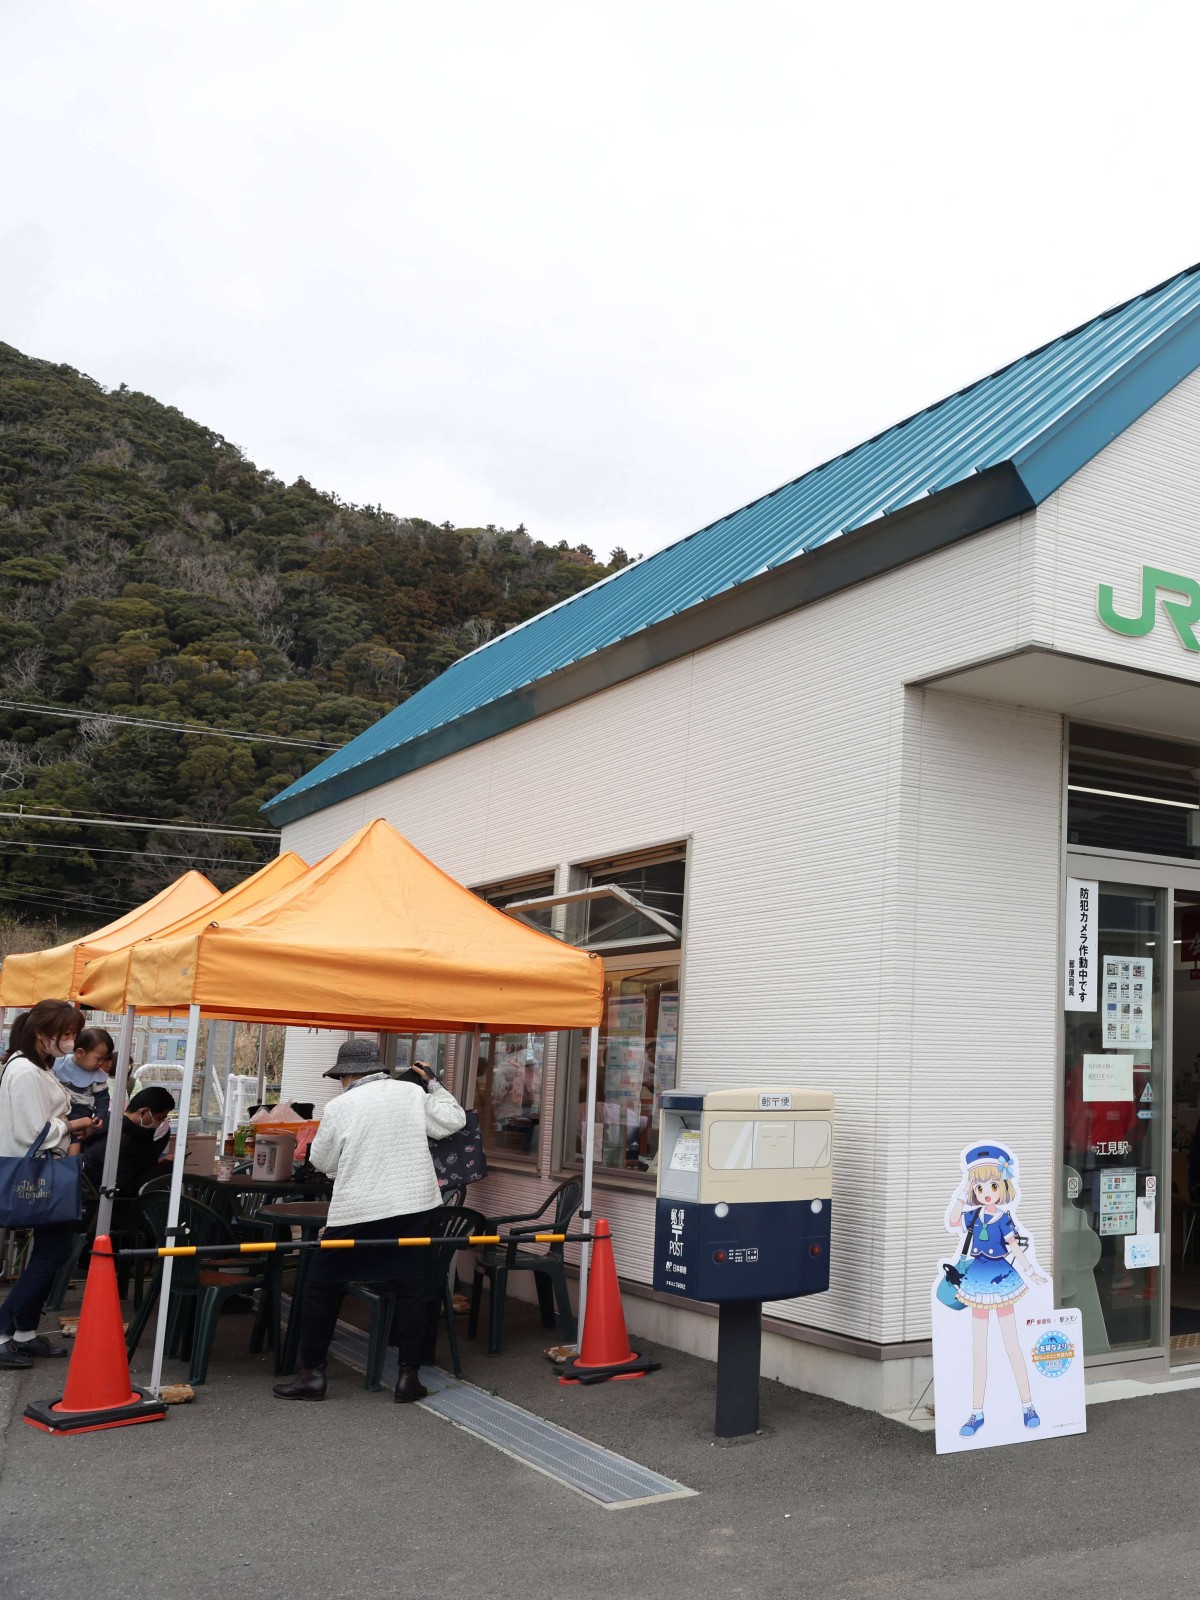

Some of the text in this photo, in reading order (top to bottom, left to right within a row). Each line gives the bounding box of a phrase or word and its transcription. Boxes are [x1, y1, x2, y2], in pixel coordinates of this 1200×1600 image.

[1079, 888, 1089, 1002] 防犯カメラ作動中です
[1096, 1141, 1129, 1155] 江見駅
[670, 1208, 685, 1227] 郵便
[669, 1240, 684, 1257] POST
